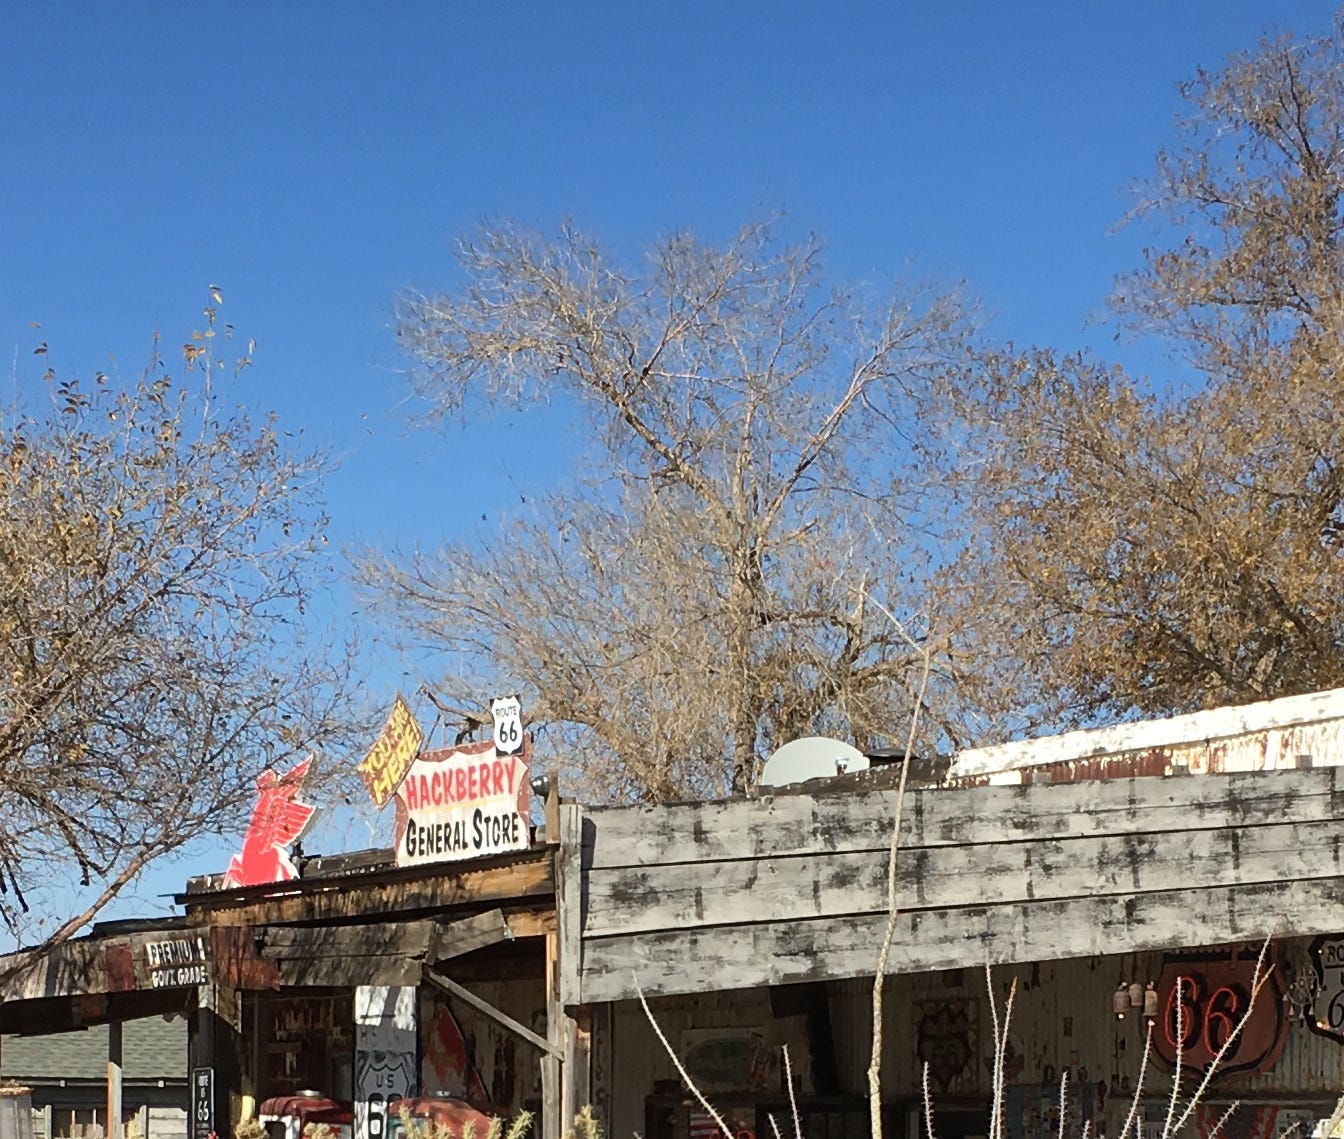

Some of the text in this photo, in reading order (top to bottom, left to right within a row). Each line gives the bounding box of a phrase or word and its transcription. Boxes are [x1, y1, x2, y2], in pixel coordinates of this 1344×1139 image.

[496, 704, 518, 718] ROUTE
[499, 720, 518, 744] 66
[405, 757, 518, 811] HACKBERRY
[406, 807, 519, 857] GENERAL STORE
[177, 965, 205, 986] GRADE
[1164, 975, 1244, 1061] 66
[376, 1073, 394, 1089] US
[197, 1100, 209, 1121] 66
